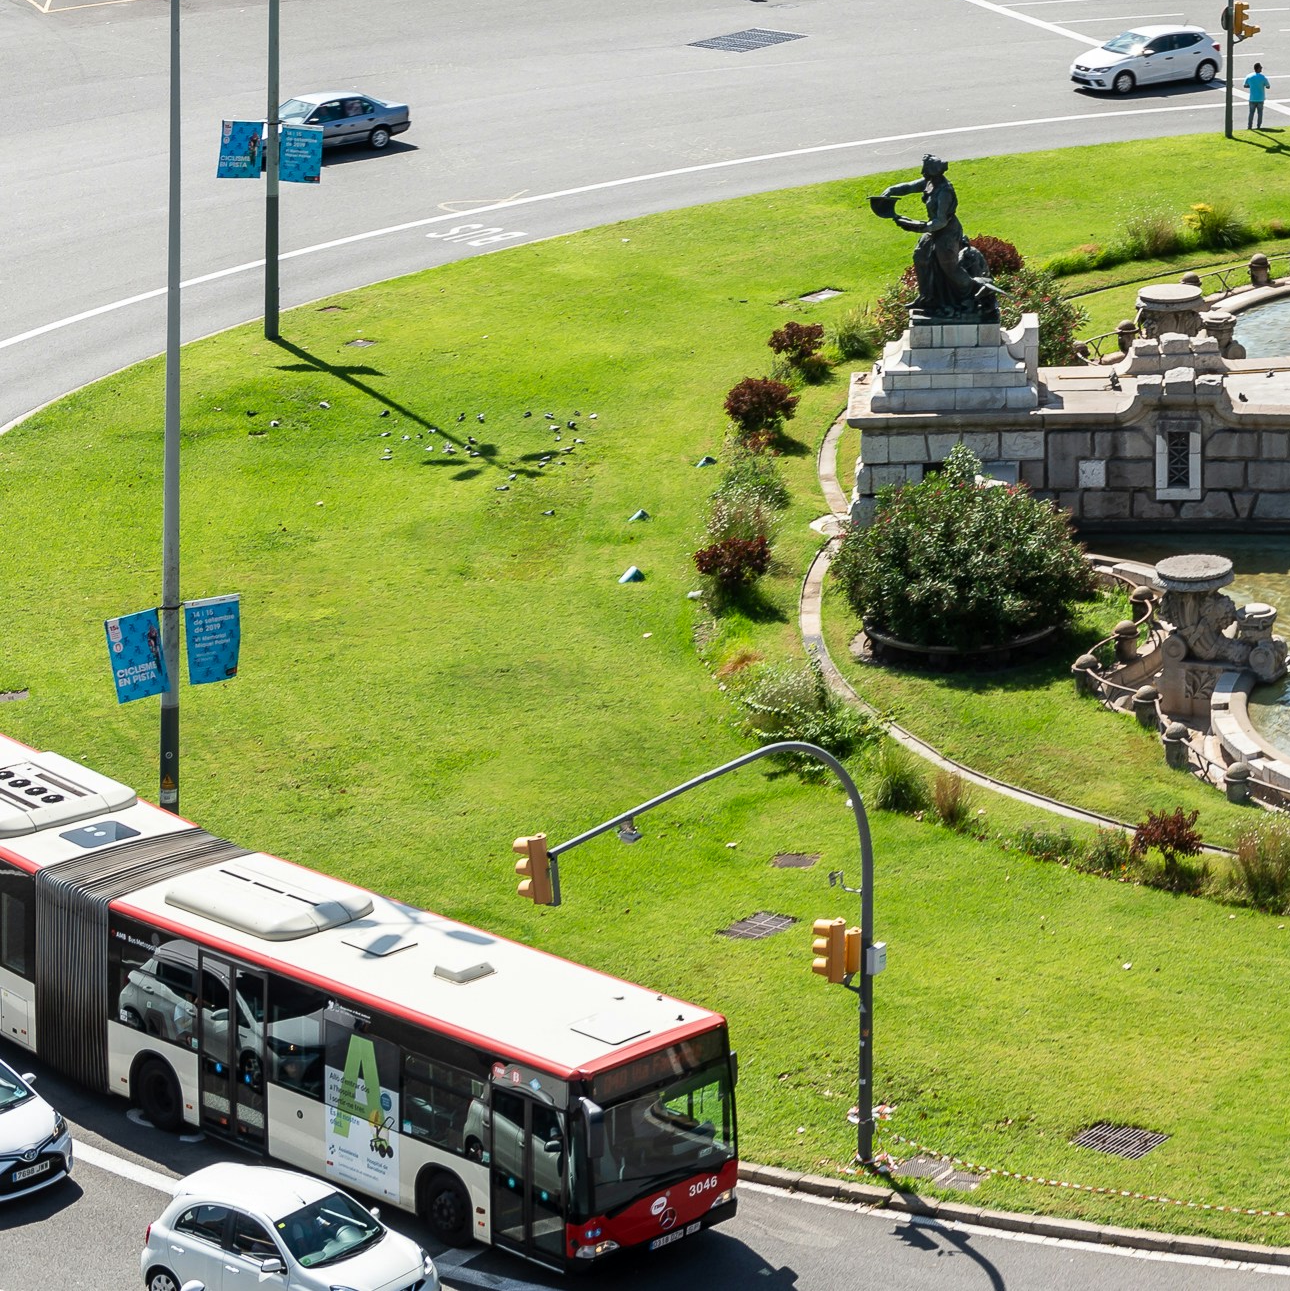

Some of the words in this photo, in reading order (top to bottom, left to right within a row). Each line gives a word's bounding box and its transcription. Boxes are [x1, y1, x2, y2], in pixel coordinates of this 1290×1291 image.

[205, 614, 235, 625] setembre
[205, 623, 221, 632] 2019
[116, 660, 158, 679] CICLISME
[118, 676, 132, 688] EN
[132, 671, 157, 685] PISTA
[17, 1167, 35, 1179] 7698
[688, 1175, 718, 1197] 3046
